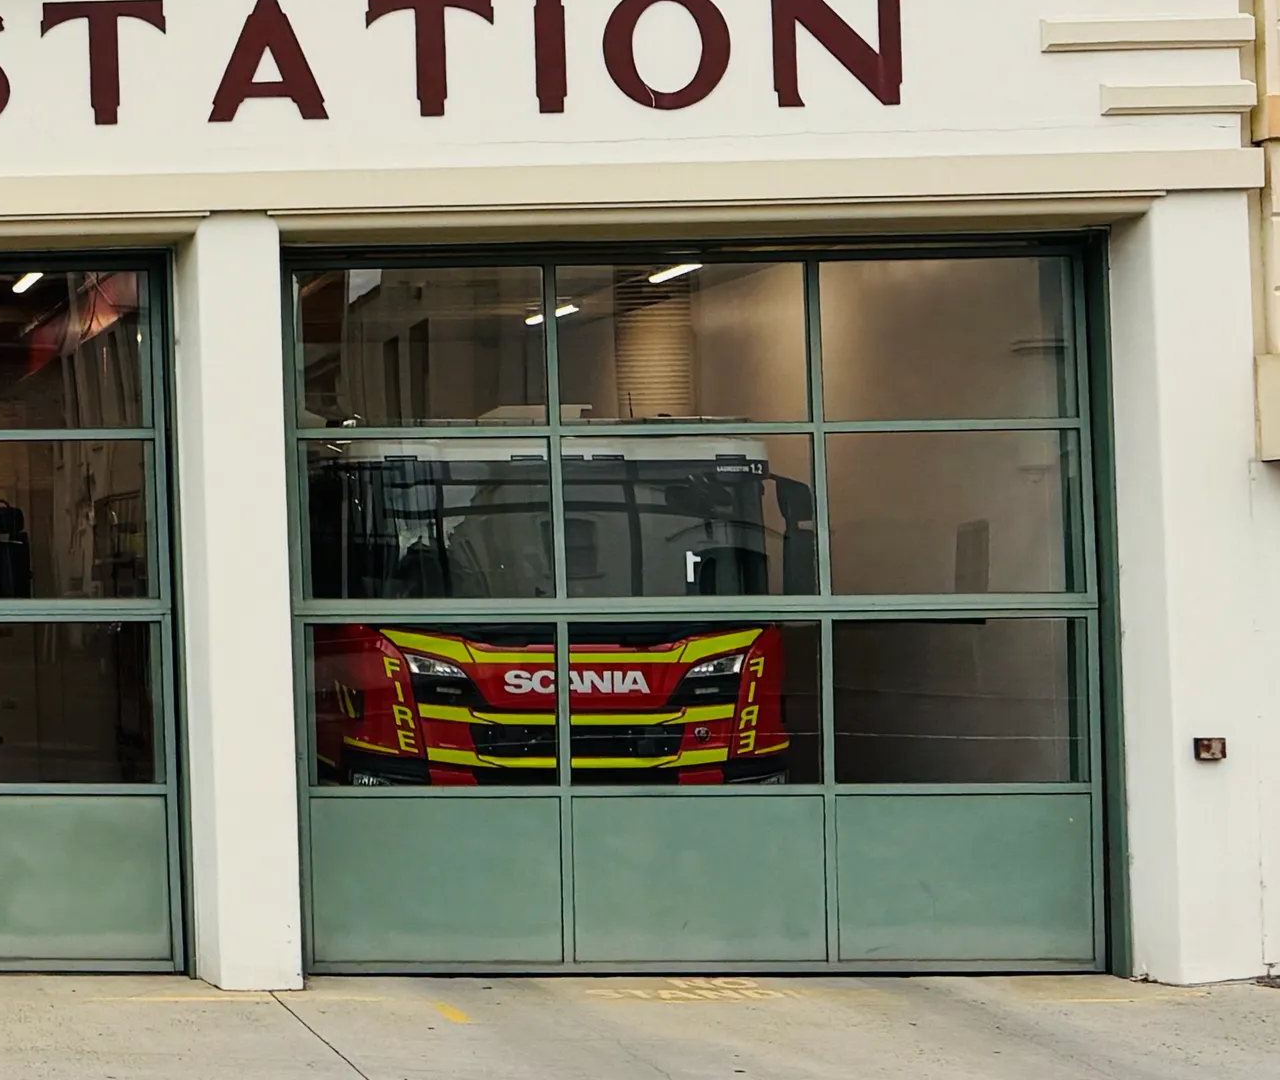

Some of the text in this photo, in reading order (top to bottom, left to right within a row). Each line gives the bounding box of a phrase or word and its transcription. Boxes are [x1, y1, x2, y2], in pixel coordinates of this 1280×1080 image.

[504, 669, 651, 694] SCANIA
[383, 656, 420, 754] FIRE
[666, 976, 759, 989] NO
